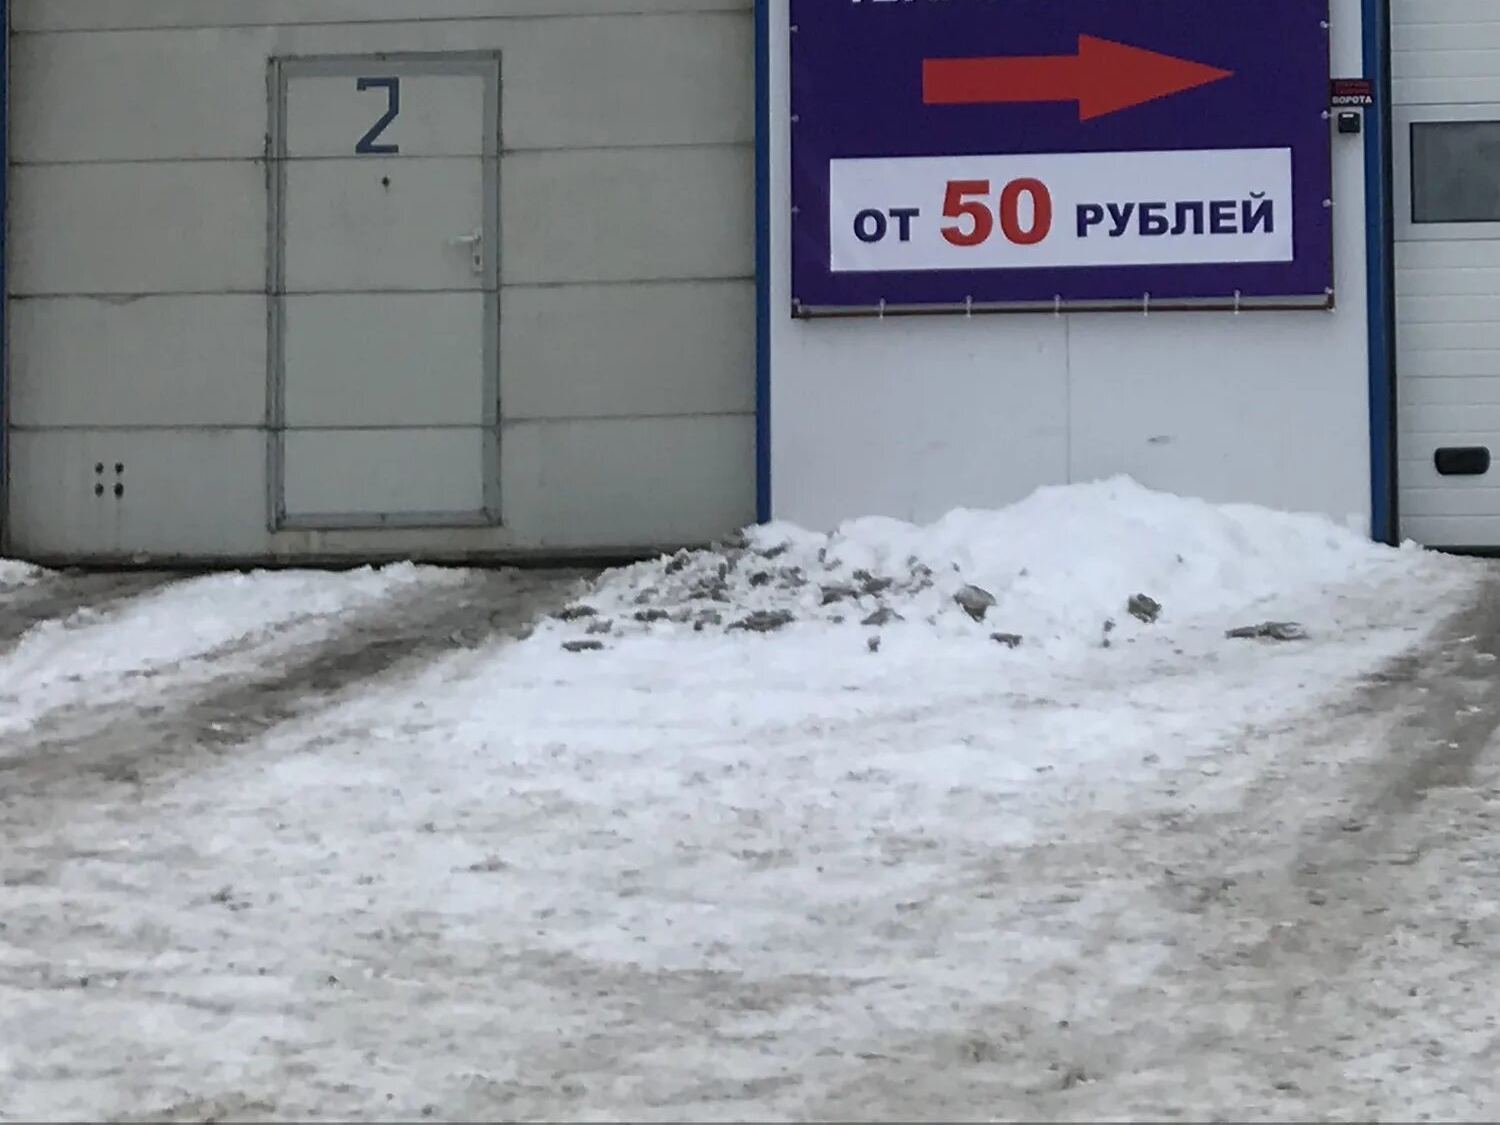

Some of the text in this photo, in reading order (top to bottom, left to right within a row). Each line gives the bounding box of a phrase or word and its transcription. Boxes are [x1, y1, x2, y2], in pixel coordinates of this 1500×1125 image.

[355, 77, 399, 154] 2
[852, 177, 1275, 248] ОТ 50 РУБЛЕЙ
